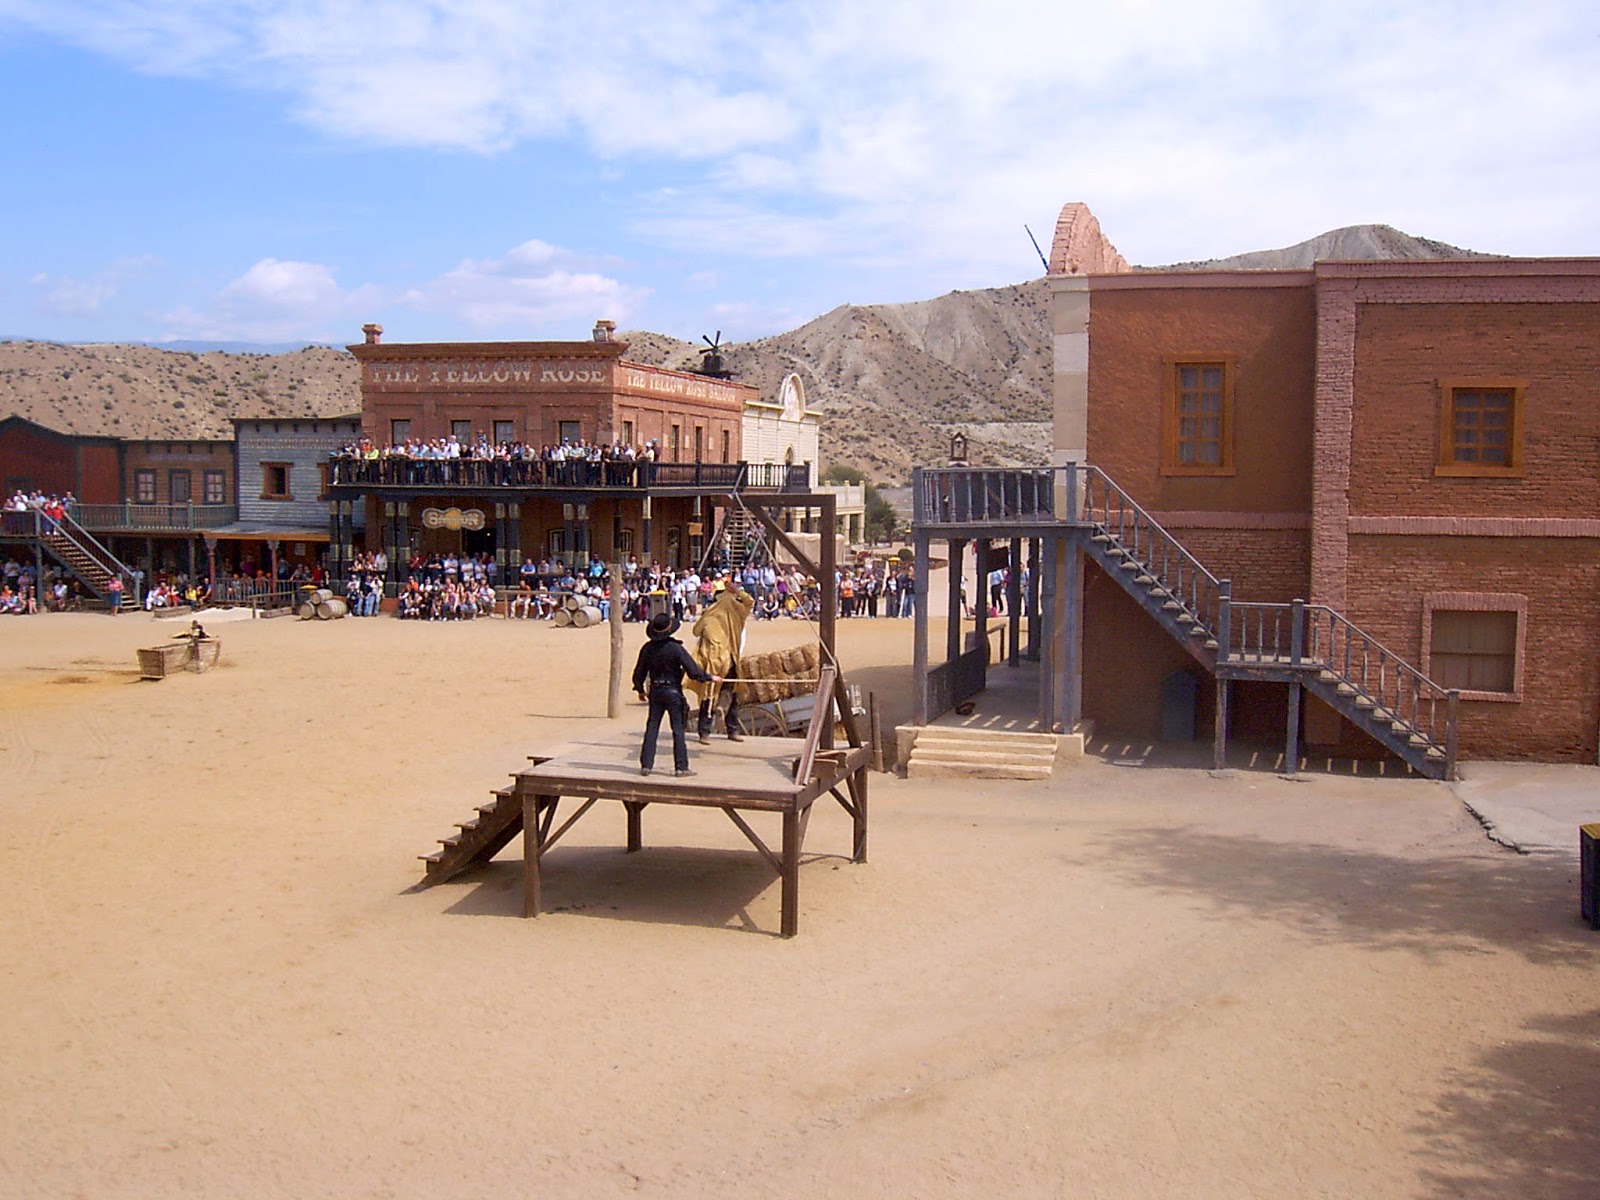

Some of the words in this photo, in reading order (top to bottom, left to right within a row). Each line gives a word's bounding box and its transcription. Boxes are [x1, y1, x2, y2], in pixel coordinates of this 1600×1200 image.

[370, 363, 419, 383] THE
[429, 363, 532, 383] YELLOW
[540, 362, 608, 383] ROSE
[627, 371, 646, 388] THE
[649, 374, 683, 393] YELLOW
[686, 380, 707, 398] ROSE
